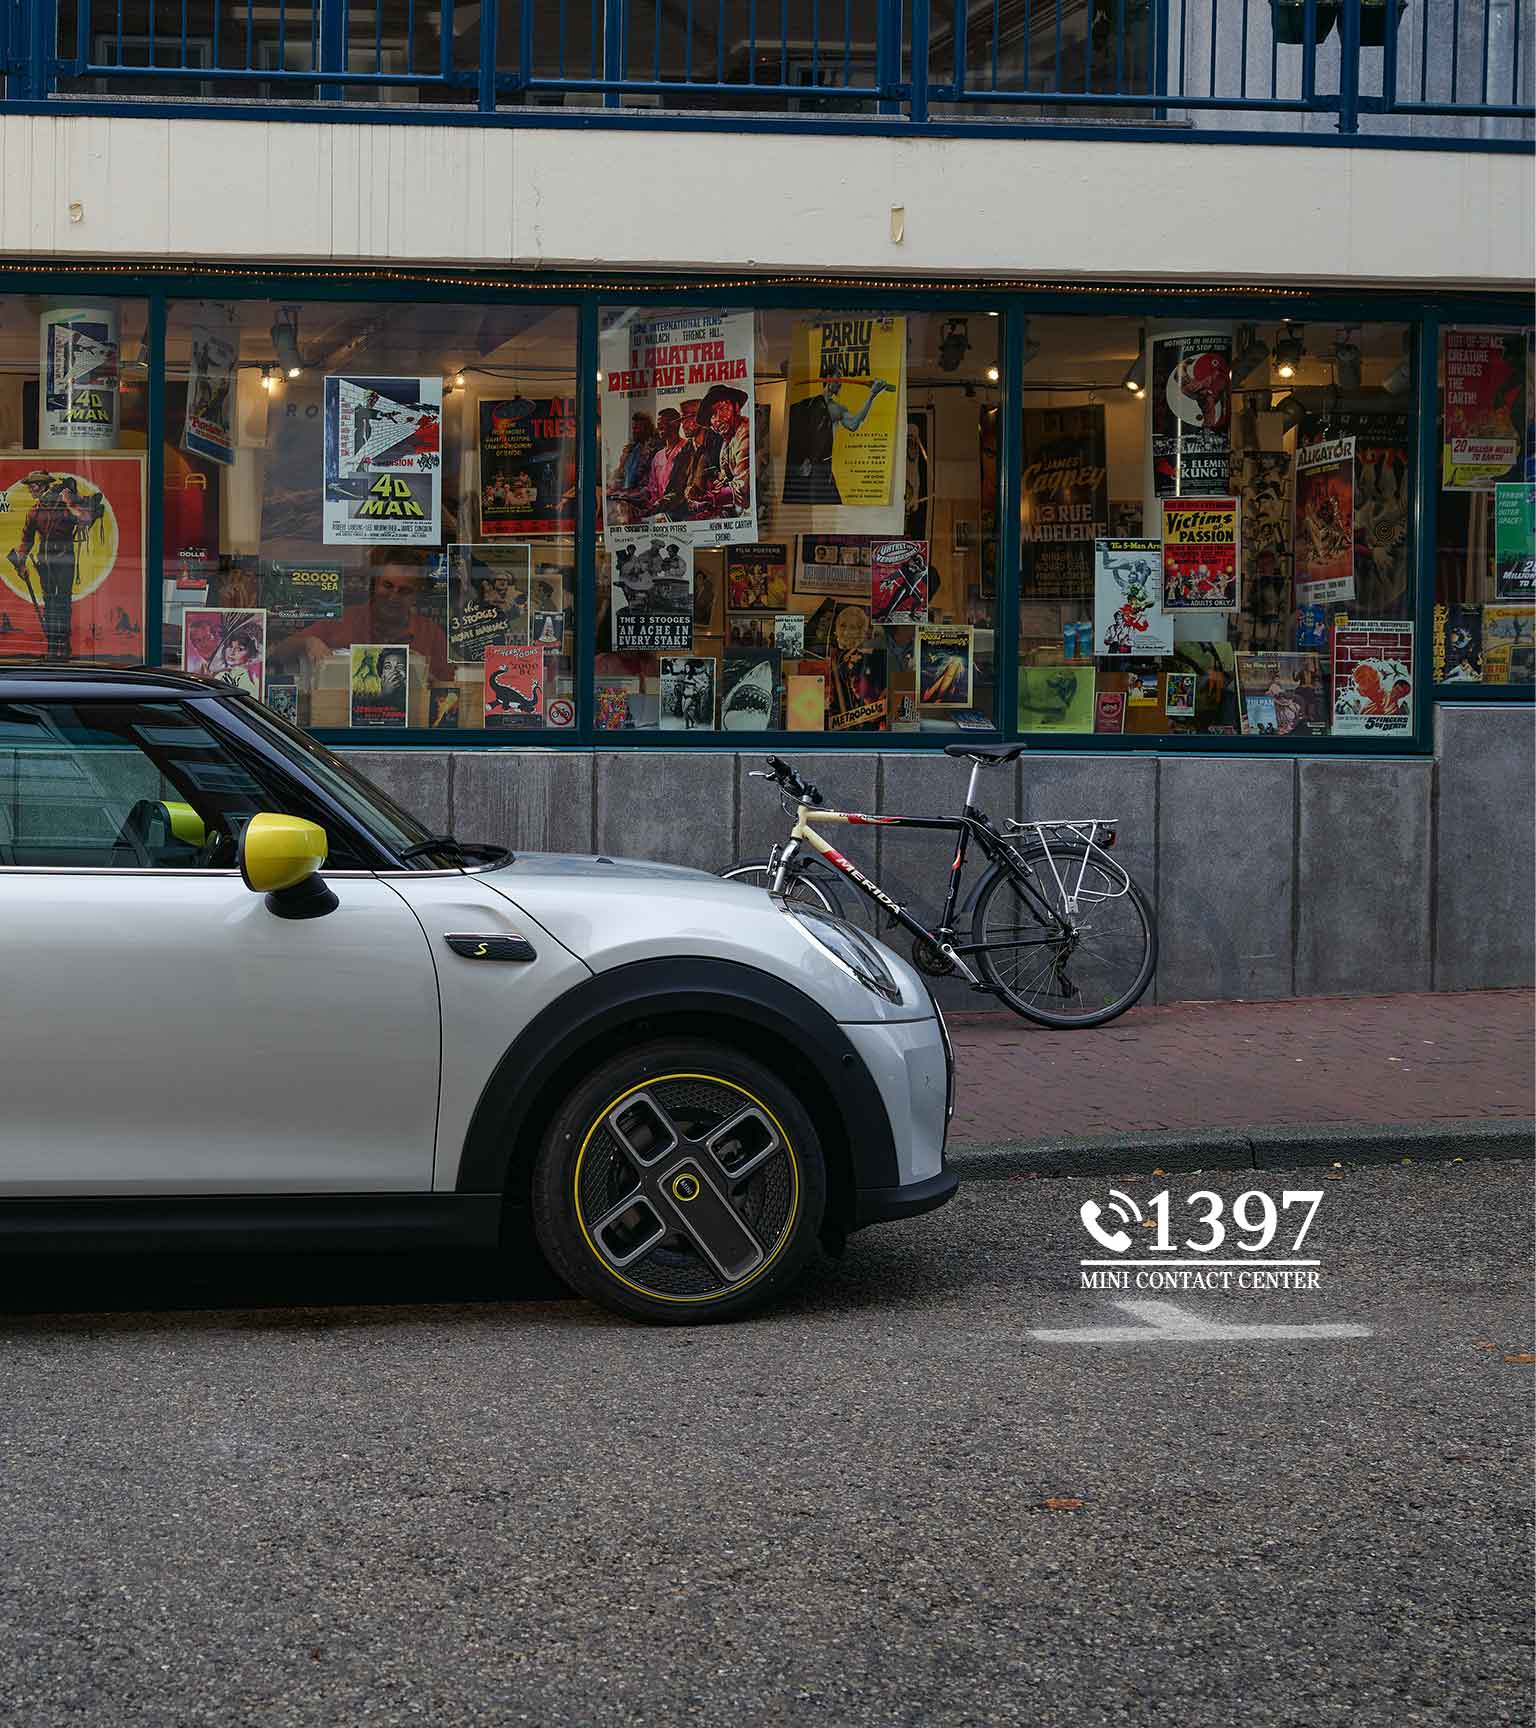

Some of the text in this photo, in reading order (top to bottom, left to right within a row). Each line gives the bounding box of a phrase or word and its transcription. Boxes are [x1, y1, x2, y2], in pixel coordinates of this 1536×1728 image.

[645, 340, 726, 369] QUATTRO
[688, 358, 748, 384] MARIA
[1448, 377, 1465, 390] THE
[76, 390, 103, 408] 4D
[63, 408, 110, 422] MAN
[1298, 442, 1352, 466] ALLIGATOR
[1181, 469, 1218, 478] KUNG
[370, 473, 412, 498] 4D
[359, 500, 425, 516] MAN
[1058, 504, 1092, 521] RUE
[1167, 512, 1233, 534] Victims
[1179, 530, 1234, 542] PASSION
[320, 582, 338, 591] SEA
[619, 616, 691, 624] THE 3 STOOGES
[639, 625, 671, 635] ACHE
[676, 625, 689, 635] IN
[618, 635, 651, 646] EVERY
[831, 703, 884, 729] METROPOLIS
[836, 856, 902, 916] MERIDA
[473, 942, 488, 956] S
